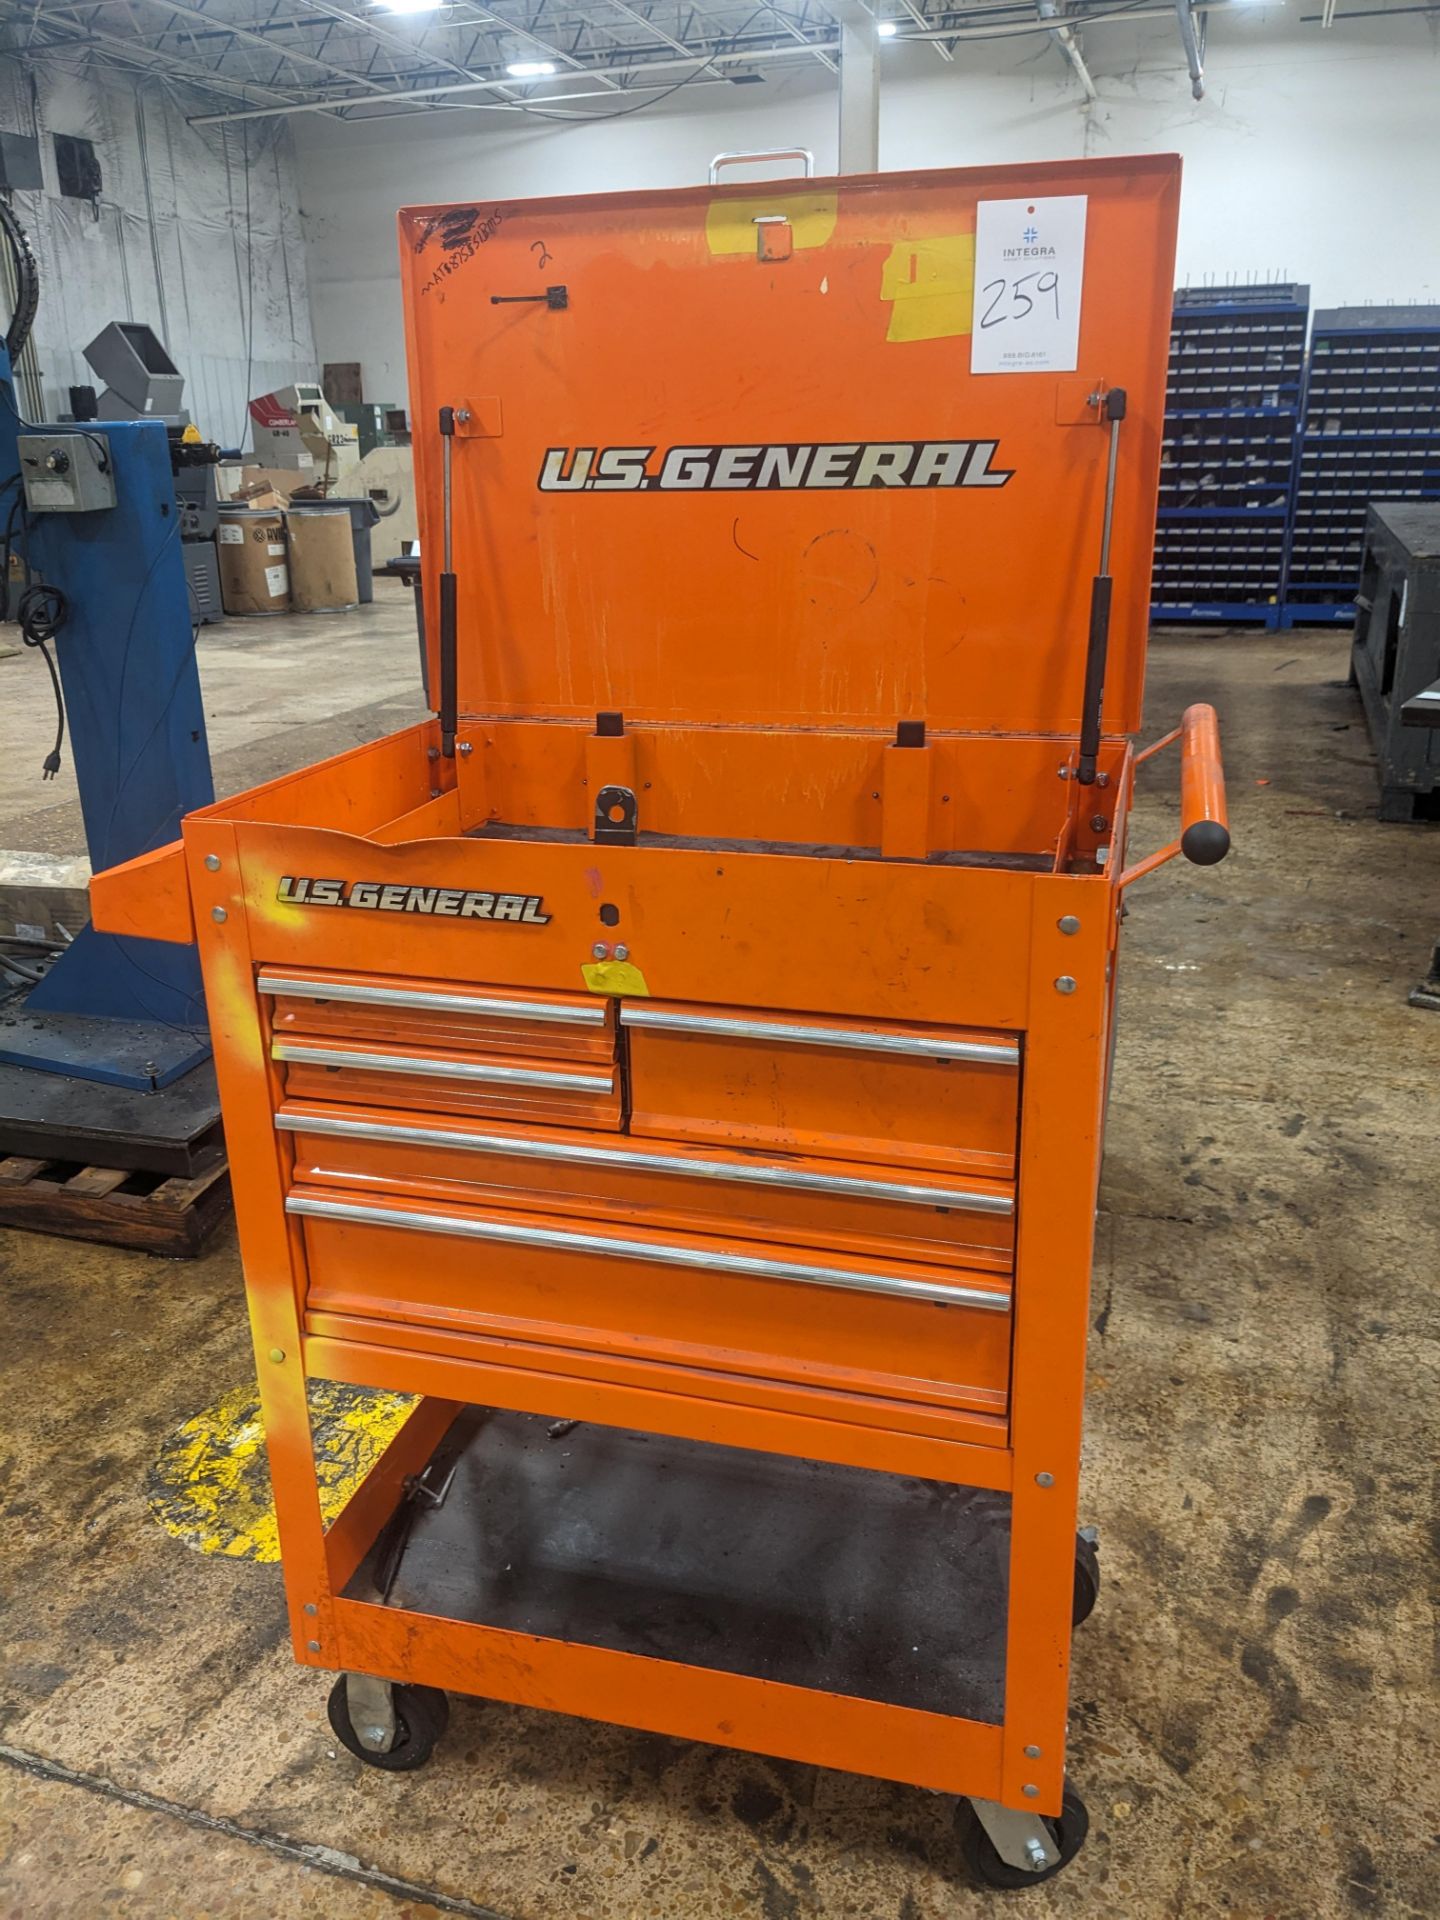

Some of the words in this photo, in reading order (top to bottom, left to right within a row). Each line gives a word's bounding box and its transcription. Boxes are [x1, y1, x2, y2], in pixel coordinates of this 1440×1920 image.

[530, 240, 553, 270] 2
[1003, 247, 1056, 257] INTEGRA
[980, 270, 1060, 329] 259
